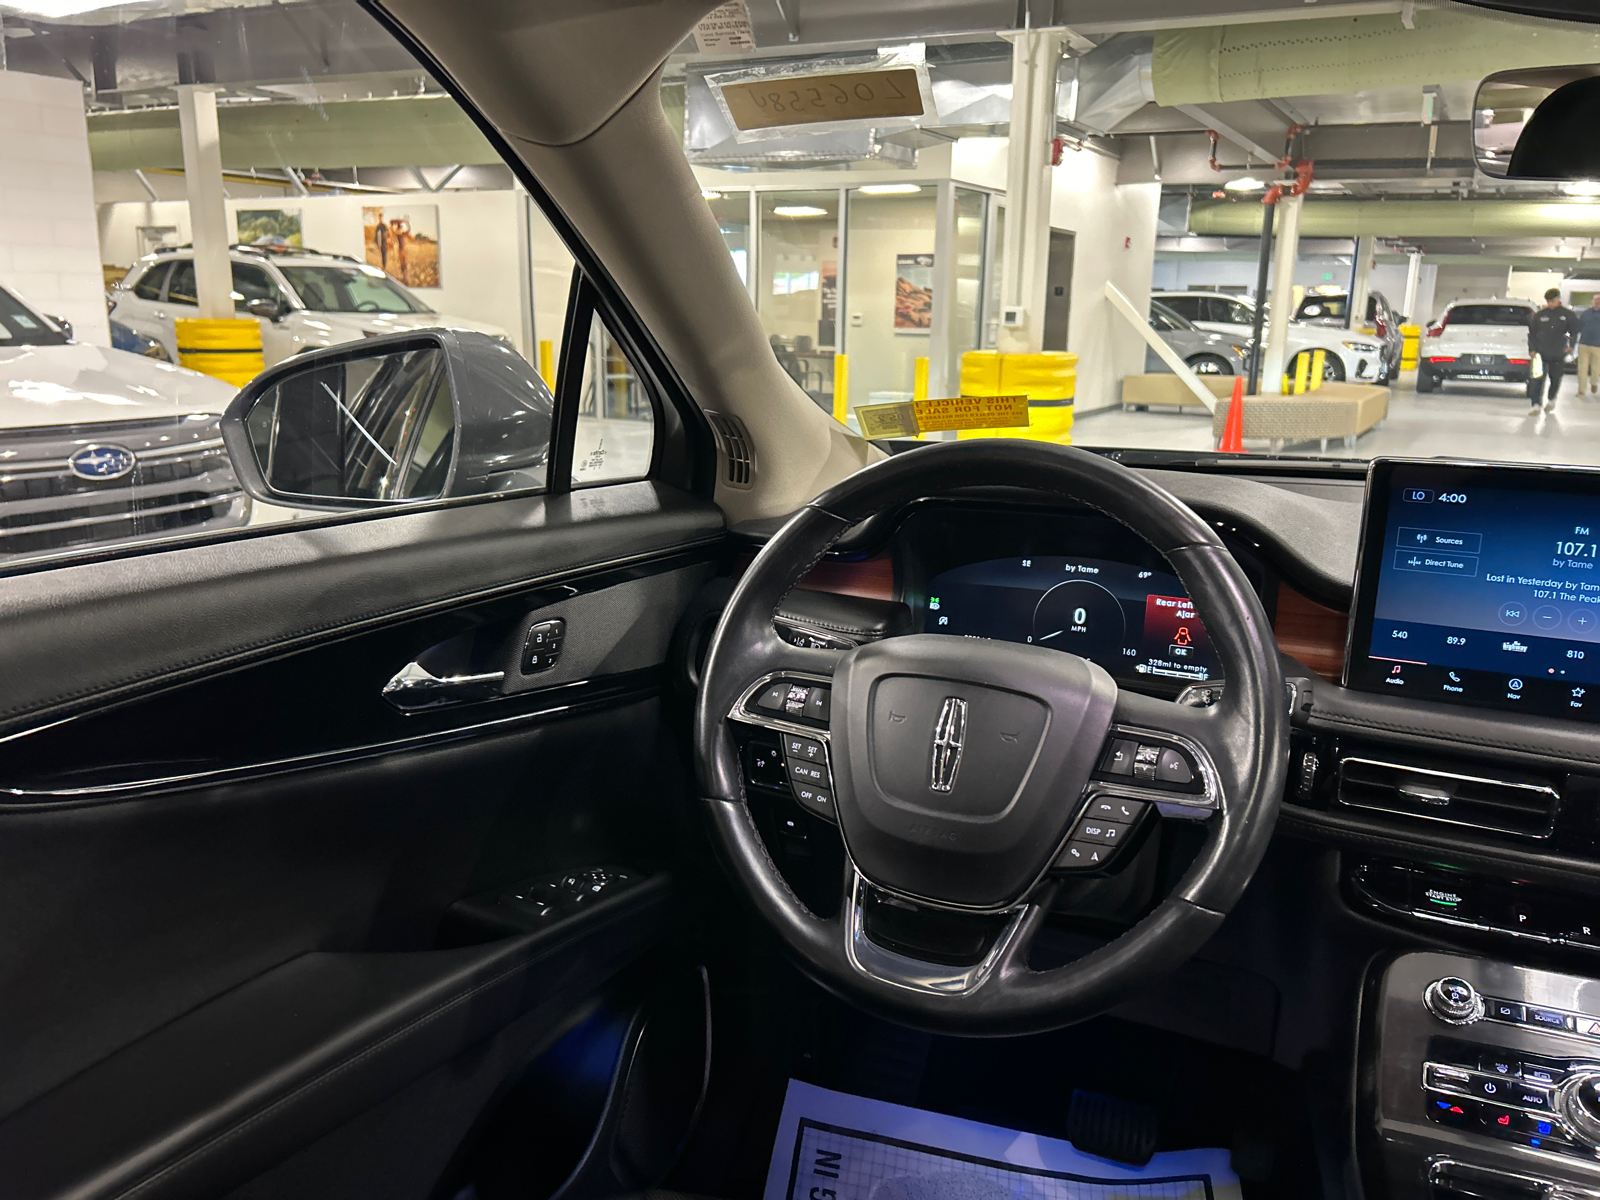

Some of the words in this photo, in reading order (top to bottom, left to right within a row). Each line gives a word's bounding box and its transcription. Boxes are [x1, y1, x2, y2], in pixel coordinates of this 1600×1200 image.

[1411, 491, 1425, 500] LO
[1438, 492, 1467, 504] 4:00
[1575, 526, 1590, 536] FM
[1435, 536, 1463, 545] Sources
[1555, 541, 1598, 558] 107.1
[1022, 559, 1031, 567] SE
[1425, 559, 1445, 568] Direct
[1446, 560, 1464, 569] Tune
[1553, 558, 1565, 569] by
[1567, 559, 1594, 570] Tame
[1065, 563, 1076, 573] by
[1077, 564, 1099, 574] Tame
[1486, 573, 1505, 583] Lost
[1506, 575, 1515, 584] in
[1518, 576, 1564, 590] Yesterday
[1565, 580, 1578, 591] by
[1580, 582, 1600, 592] Tam
[1534, 589, 1557, 600] 107.1
[1560, 592, 1577, 602] The
[1156, 598, 1176, 607] Rear
[1074, 607, 1087, 625] 0
[1175, 610, 1196, 619] Ajar
[1071, 625, 1087, 633] MPH
[1027, 635, 1032, 643] 0
[1391, 630, 1408, 639] 540
[1446, 636, 1467, 646] 89.9
[1122, 648, 1137, 657] 160
[1175, 648, 1188, 656] OK
[1566, 650, 1585, 659] 810
[1183, 665, 1207, 674] empty
[1385, 677, 1404, 685] Audio
[1443, 684, 1463, 693] Phone
[1507, 692, 1521, 700] Nav
[1570, 700, 1583, 708] Fav
[791, 742, 802, 750] SET
[807, 745, 818, 754] SET
[795, 766, 808, 775] CAN
[810, 770, 821, 779] RES
[801, 791, 813, 799] OFF
[816, 795, 827, 803] ON
[1085, 826, 1102, 835] DISP
[1429, 888, 1457, 899] ENGINE
[1519, 914, 1527, 922] P
[1583, 926, 1591, 935] R
[1522, 1094, 1543, 1104] AUTO
[813, 1148, 842, 1179] IN
